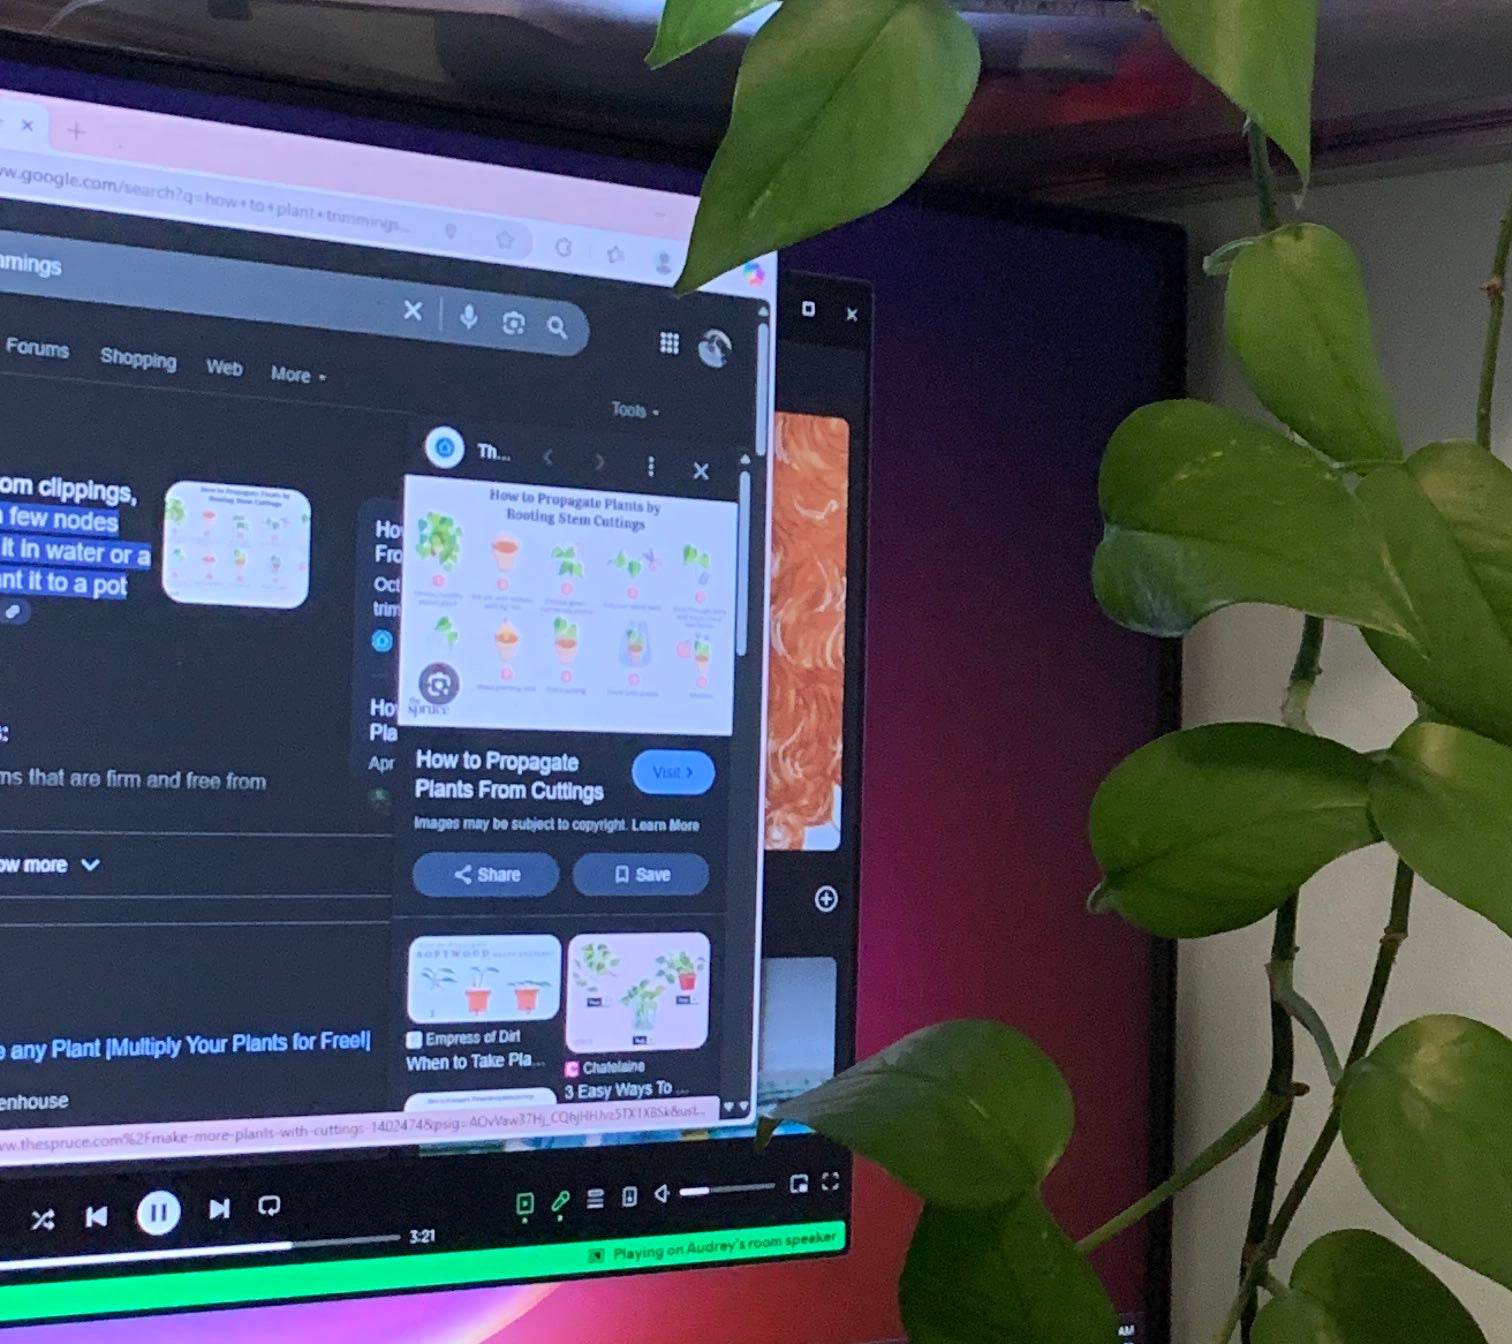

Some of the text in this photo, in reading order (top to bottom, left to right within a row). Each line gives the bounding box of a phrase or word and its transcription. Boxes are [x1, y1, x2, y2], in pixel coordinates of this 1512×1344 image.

[5, 337, 70, 359] Forums
[100, 346, 177, 374] Shopping
[206, 358, 244, 377] Web
[271, 365, 311, 383] More
[612, 401, 647, 419] Tools
[39, 476, 138, 507] clippings,
[490, 488, 661, 517] How to Propagate Plants by
[9, 506, 48, 527] few
[54, 510, 119, 532] nodes
[375, 519, 403, 539] Ho
[507, 508, 645, 533] Rooting Stem Cuttings
[2, 537, 151, 567] it in water or a
[0, 570, 128, 600] nt it to a pot
[370, 698, 398, 717] Ho
[367, 755, 396, 774] Apr
[416, 748, 580, 777] How to Propagate
[653, 765, 681, 779] Visit
[29, 767, 65, 786] that
[70, 772, 100, 786] are
[106, 769, 141, 788] firm
[147, 771, 181, 789] and
[186, 771, 222, 790] free
[226, 772, 267, 791] from
[415, 778, 604, 805] Plants From Cuttings
[414, 816, 700, 836] Images may be subject to copyright. Learn More
[23, 858, 69, 874] more
[478, 867, 521, 883] Share
[636, 867, 671, 883] Save
[11, 1042, 47, 1064] any
[52, 1038, 101, 1058] Plant
[186, 1034, 228, 1055] Your
[232, 1033, 288, 1053] Plants
[292, 1032, 316, 1052] for
[426, 1029, 521, 1047] Empress of Dirt
[406, 1057, 449, 1072] When
[453, 1056, 467, 1071] to
[471, 1054, 504, 1069] Take
[583, 1060, 645, 1075] Chatelaine
[564, 1085, 574, 1100] 3
[577, 1083, 612, 1102] Easy
[615, 1081, 652, 1099] Ways
[656, 1079, 673, 1094] To
[409, 1229, 436, 1244] 3:21
[613, 1230, 838, 1262] Playing on Audrey's room speaker
